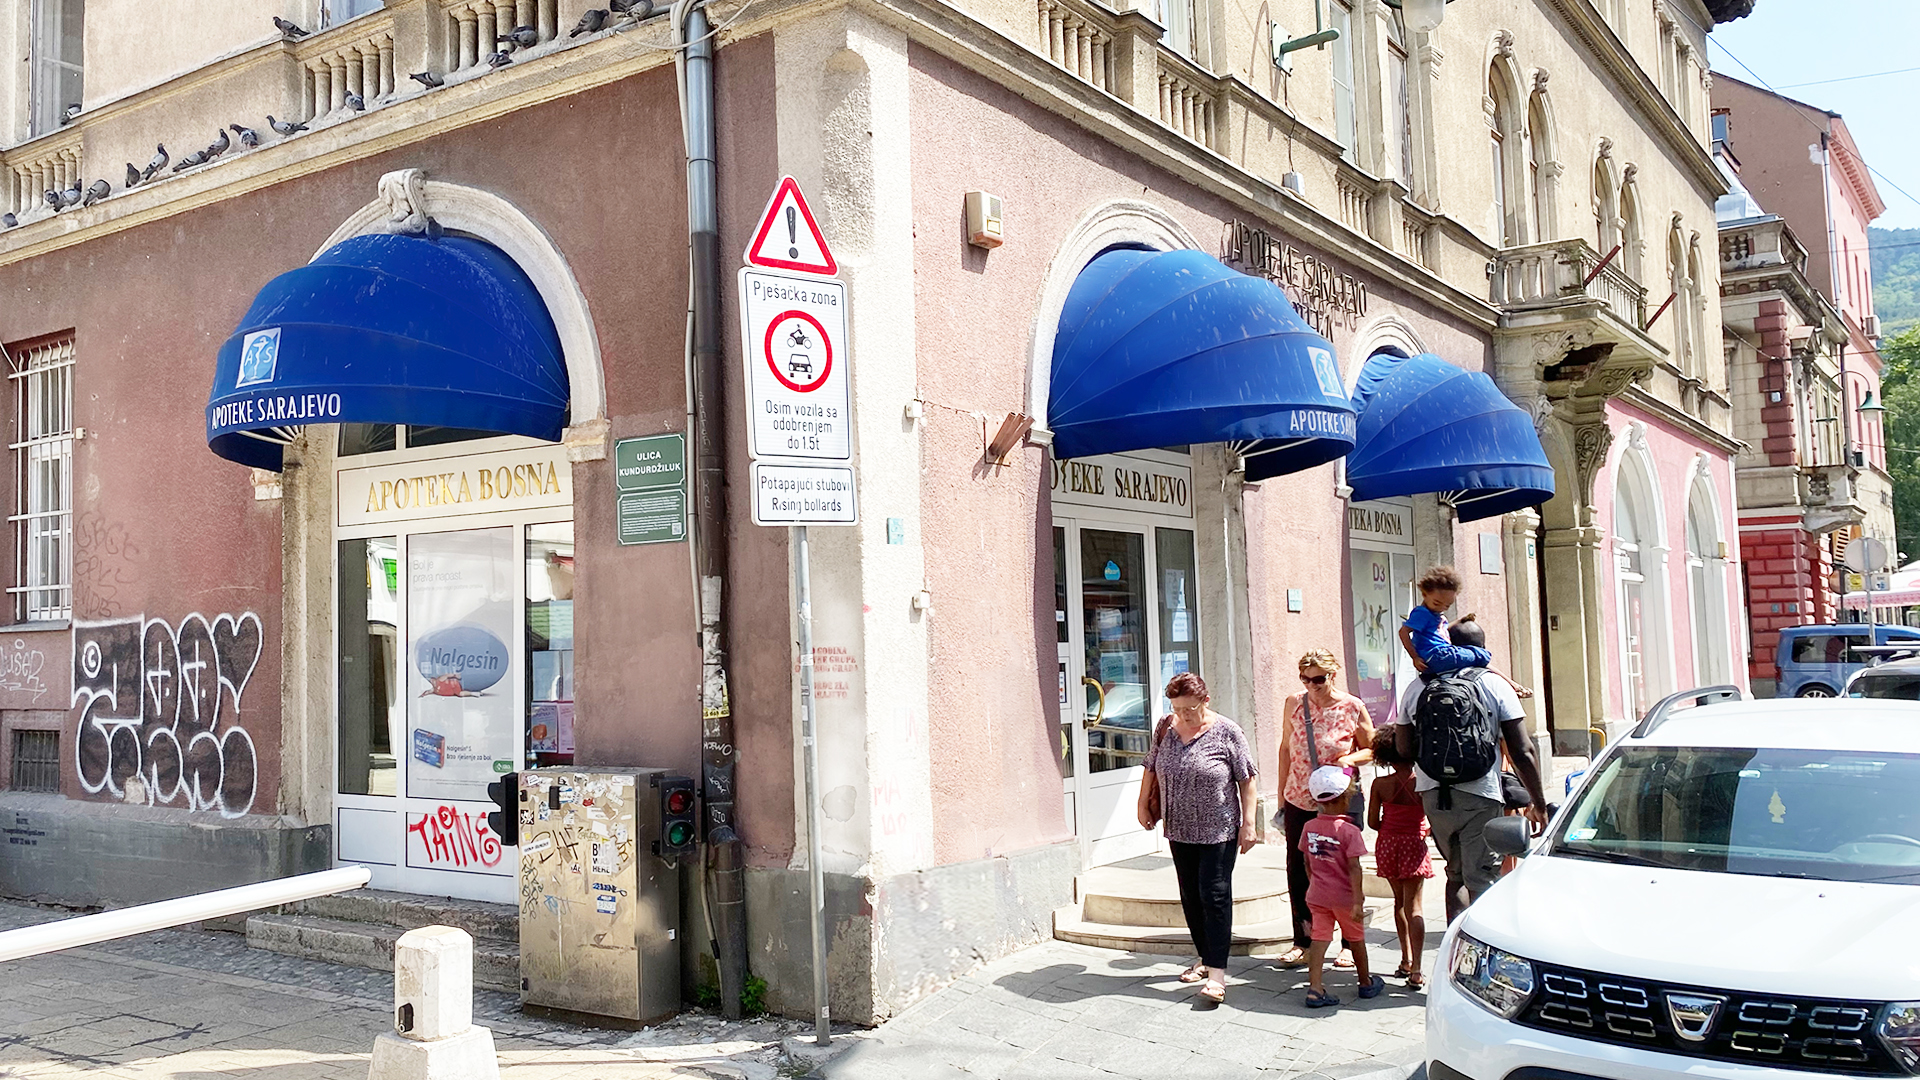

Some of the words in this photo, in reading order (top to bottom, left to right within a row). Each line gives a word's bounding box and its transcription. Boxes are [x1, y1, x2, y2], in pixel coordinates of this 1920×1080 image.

[753, 280, 808, 302] Pješačka
[811, 292, 837, 306] zona
[211, 400, 254, 430] APOTEKE
[257, 393, 341, 421] SARAJEVO
[765, 399, 791, 415] Osim
[794, 403, 823, 417] vozila
[826, 407, 838, 418] sa
[773, 416, 832, 436] odobrenjem
[1290, 410, 1340, 434] APOTEKE
[787, 435, 800, 449] do
[636, 451, 661, 461] ULICA
[619, 462, 681, 477] KUNDURDŽILUK
[365, 471, 473, 513] APOTEKA
[478, 460, 561, 501] BOSNA
[761, 475, 814, 494] Potapajući
[816, 477, 850, 492] stubovi
[1114, 467, 1187, 507] SARAJEVO
[772, 497, 802, 514] Rising
[804, 498, 842, 512] bollards
[1374, 510, 1403, 535] BOSNA
[412, 559, 426, 570] Bol
[427, 559, 434, 571] je
[1372, 562, 1386, 582] D3
[412, 573, 434, 584] prava
[430, 648, 498, 672] Nalgesin
